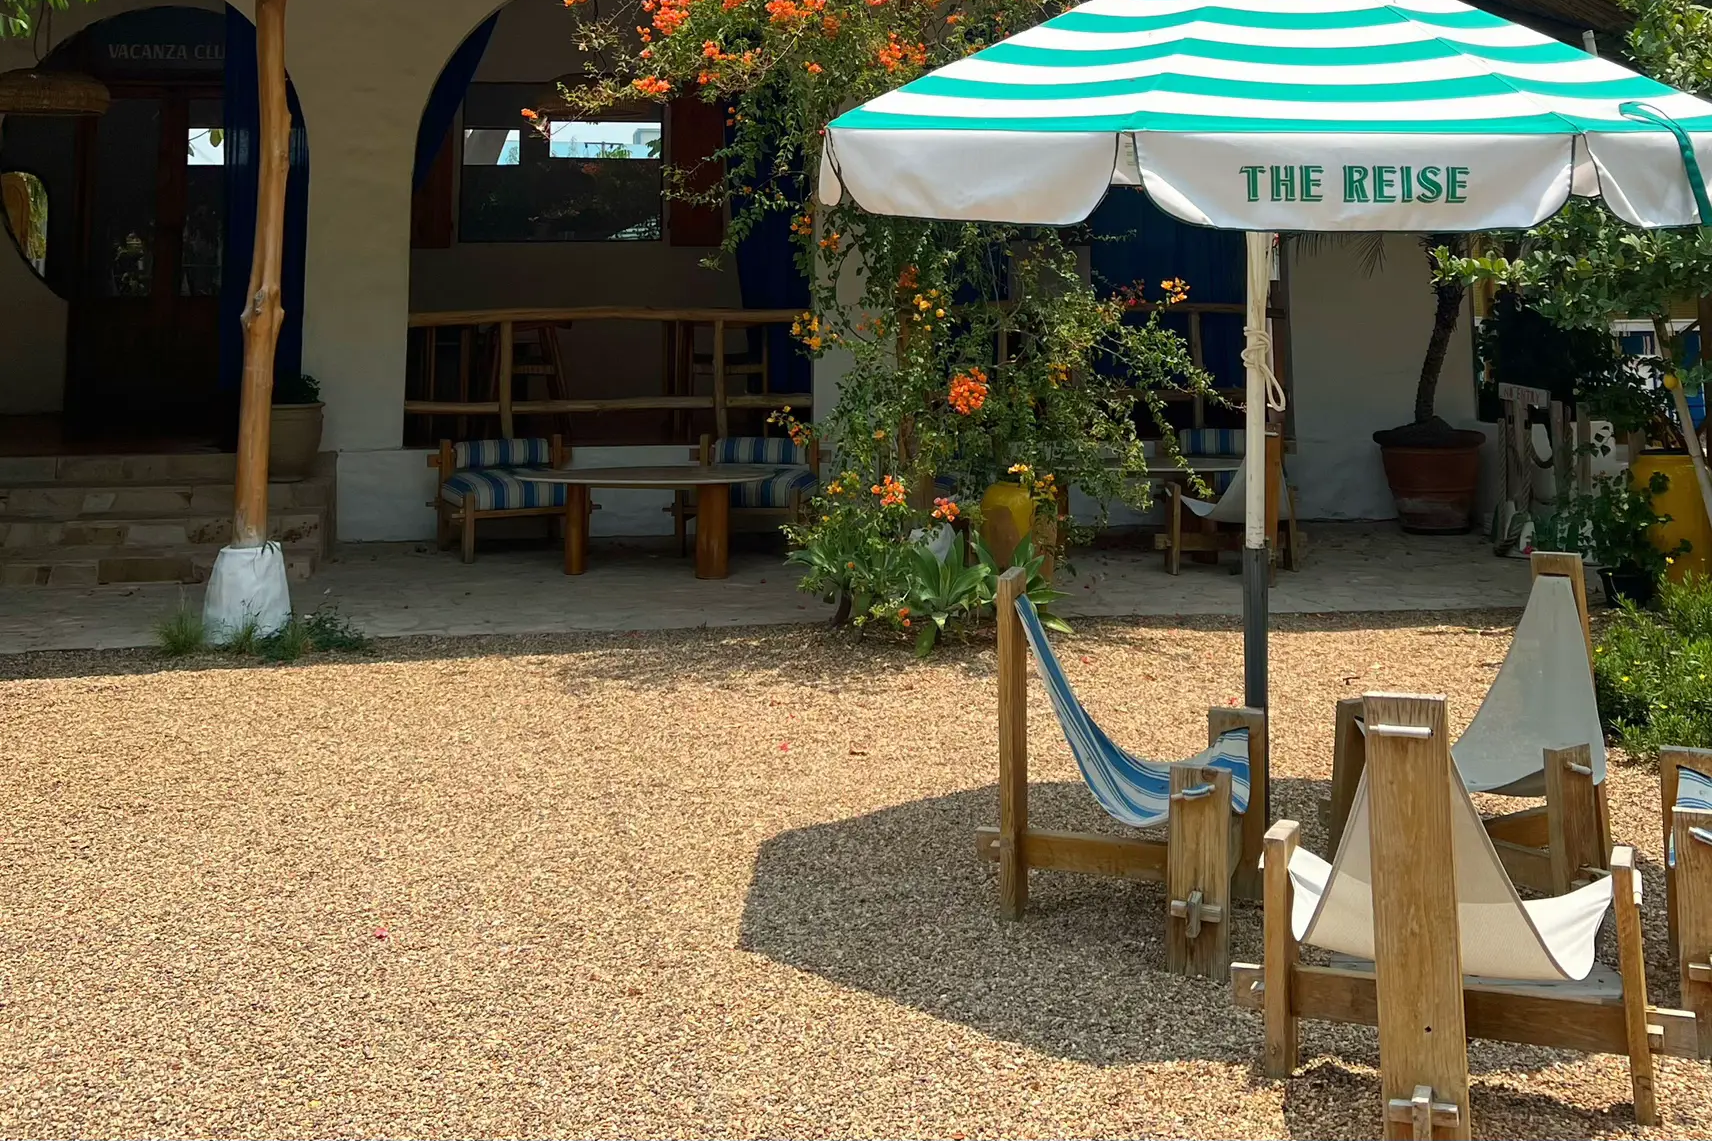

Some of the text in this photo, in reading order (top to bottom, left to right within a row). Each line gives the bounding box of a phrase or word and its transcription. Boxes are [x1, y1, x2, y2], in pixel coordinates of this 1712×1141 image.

[107, 43, 227, 59] VACANZA CLU
[1239, 165, 1470, 204] THE REISE
